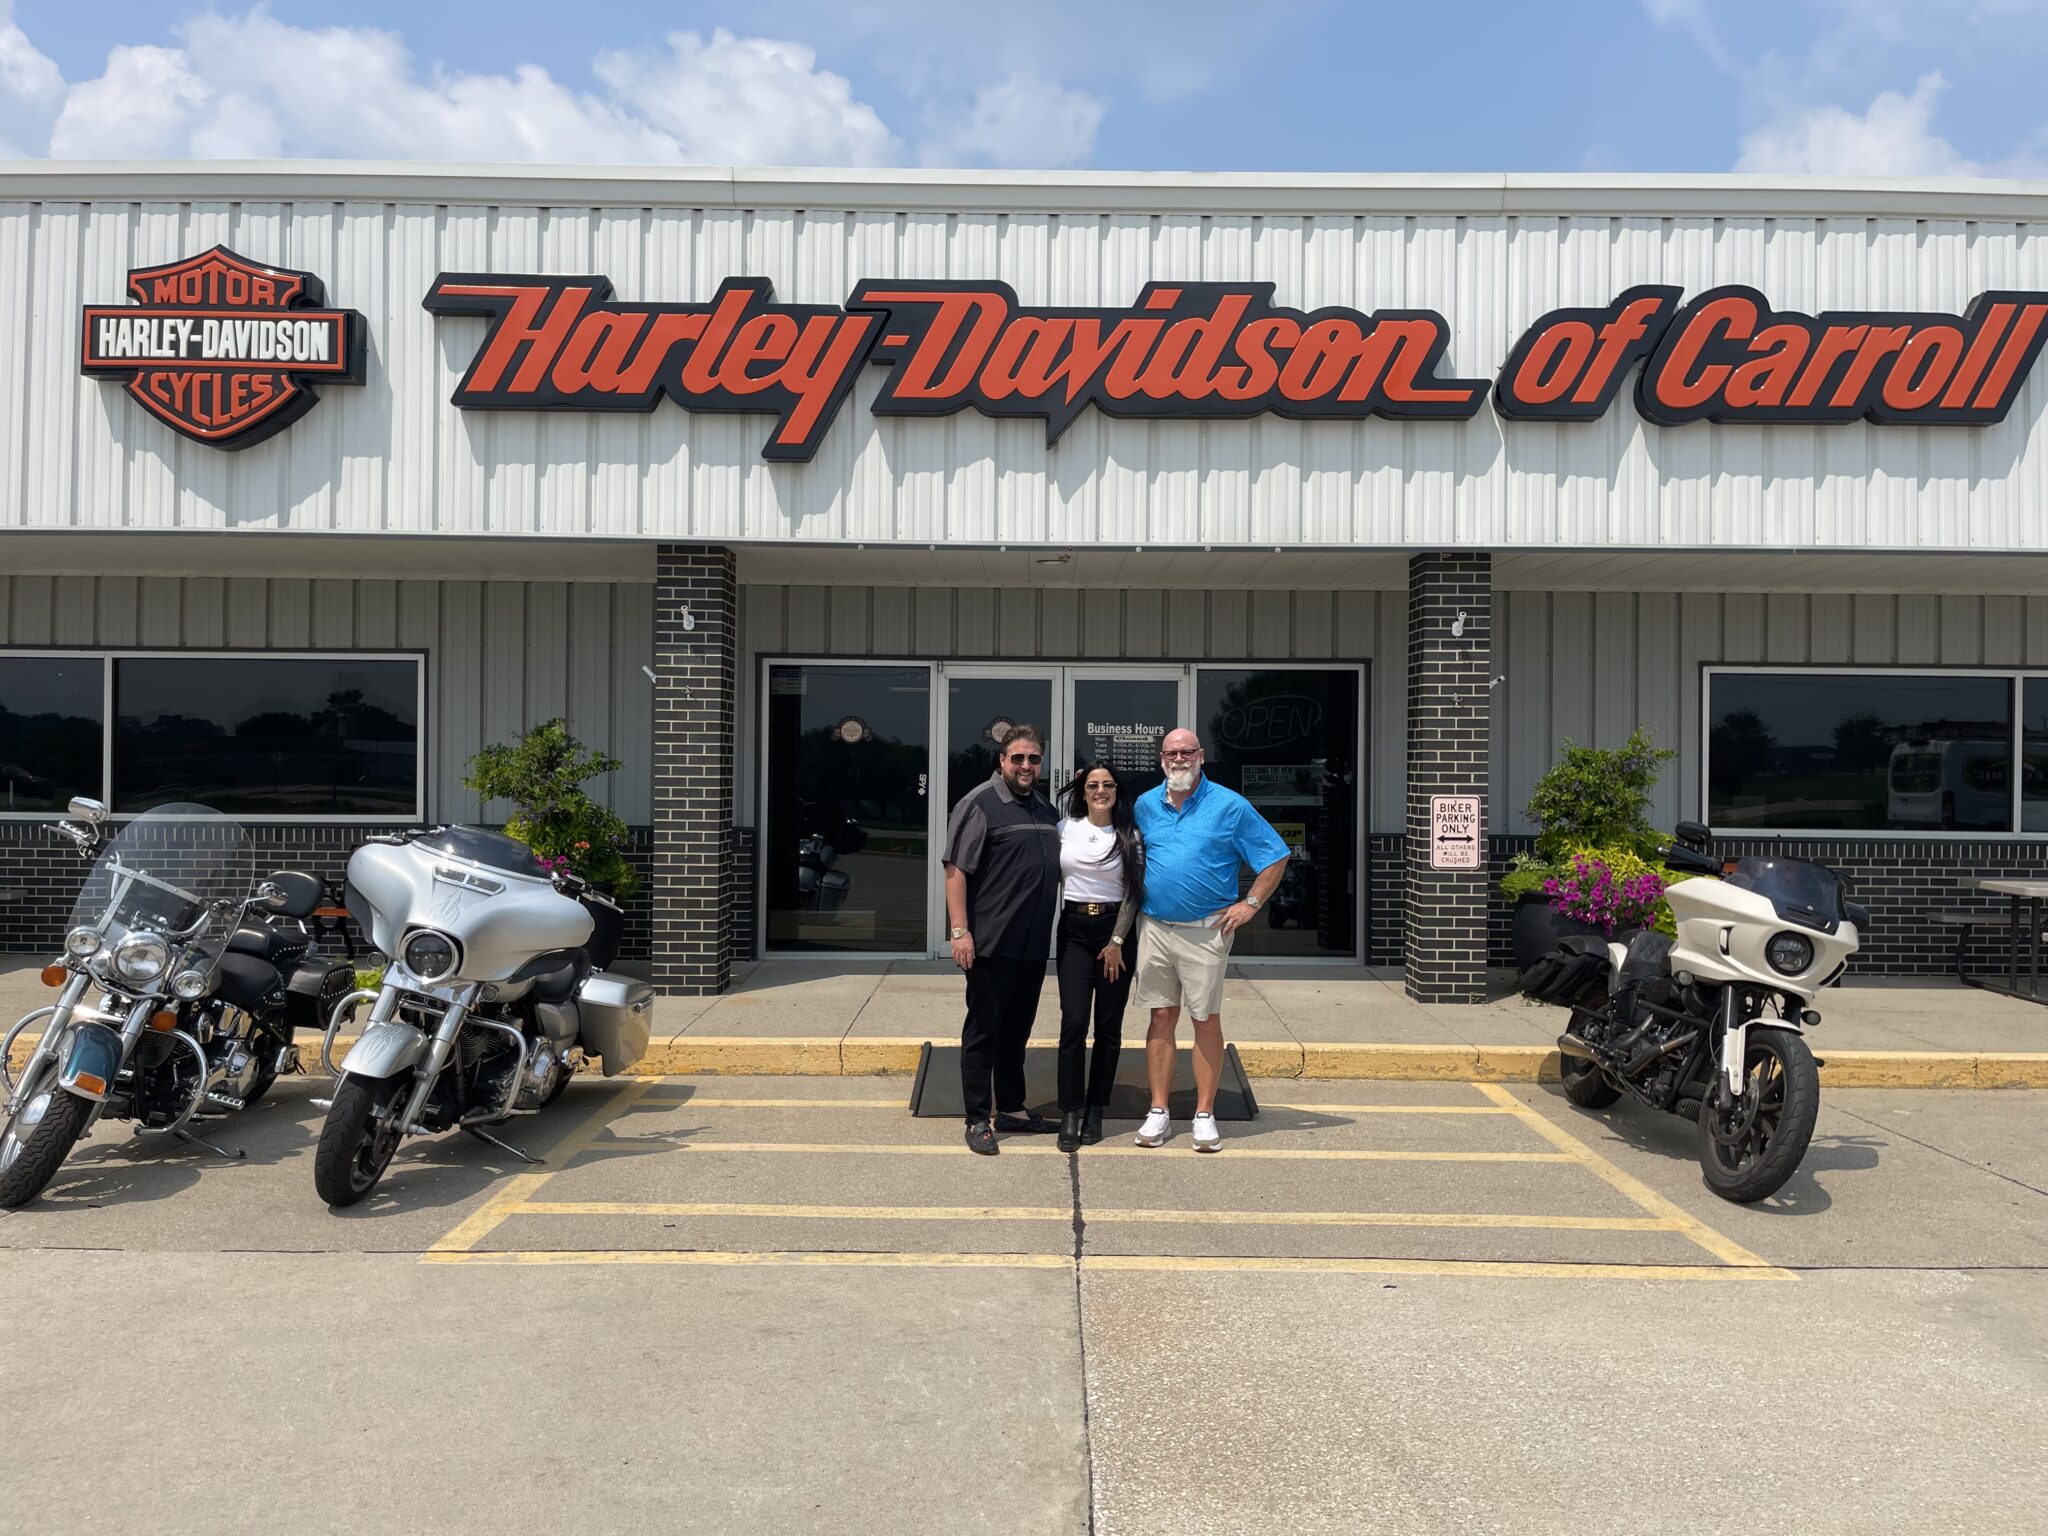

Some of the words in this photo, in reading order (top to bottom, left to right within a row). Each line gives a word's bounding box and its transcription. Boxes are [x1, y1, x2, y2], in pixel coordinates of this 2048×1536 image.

[154, 260, 276, 306] MOTOR
[98, 318, 330, 361] HARLEY-DAVIDSON
[437, 284, 1475, 445] Harley-Davidson
[1512, 297, 1664, 404] of
[1655, 297, 2048, 409] Carroll
[150, 371, 274, 426] CYCLES
[1087, 722, 1132, 734] Business
[1135, 723, 1165, 735] Hours
[1222, 705, 1314, 739] OPEN
[1436, 814, 1476, 823] PARKING
[1440, 802, 1472, 813] BIKER
[1441, 824, 1469, 833] ONLY
